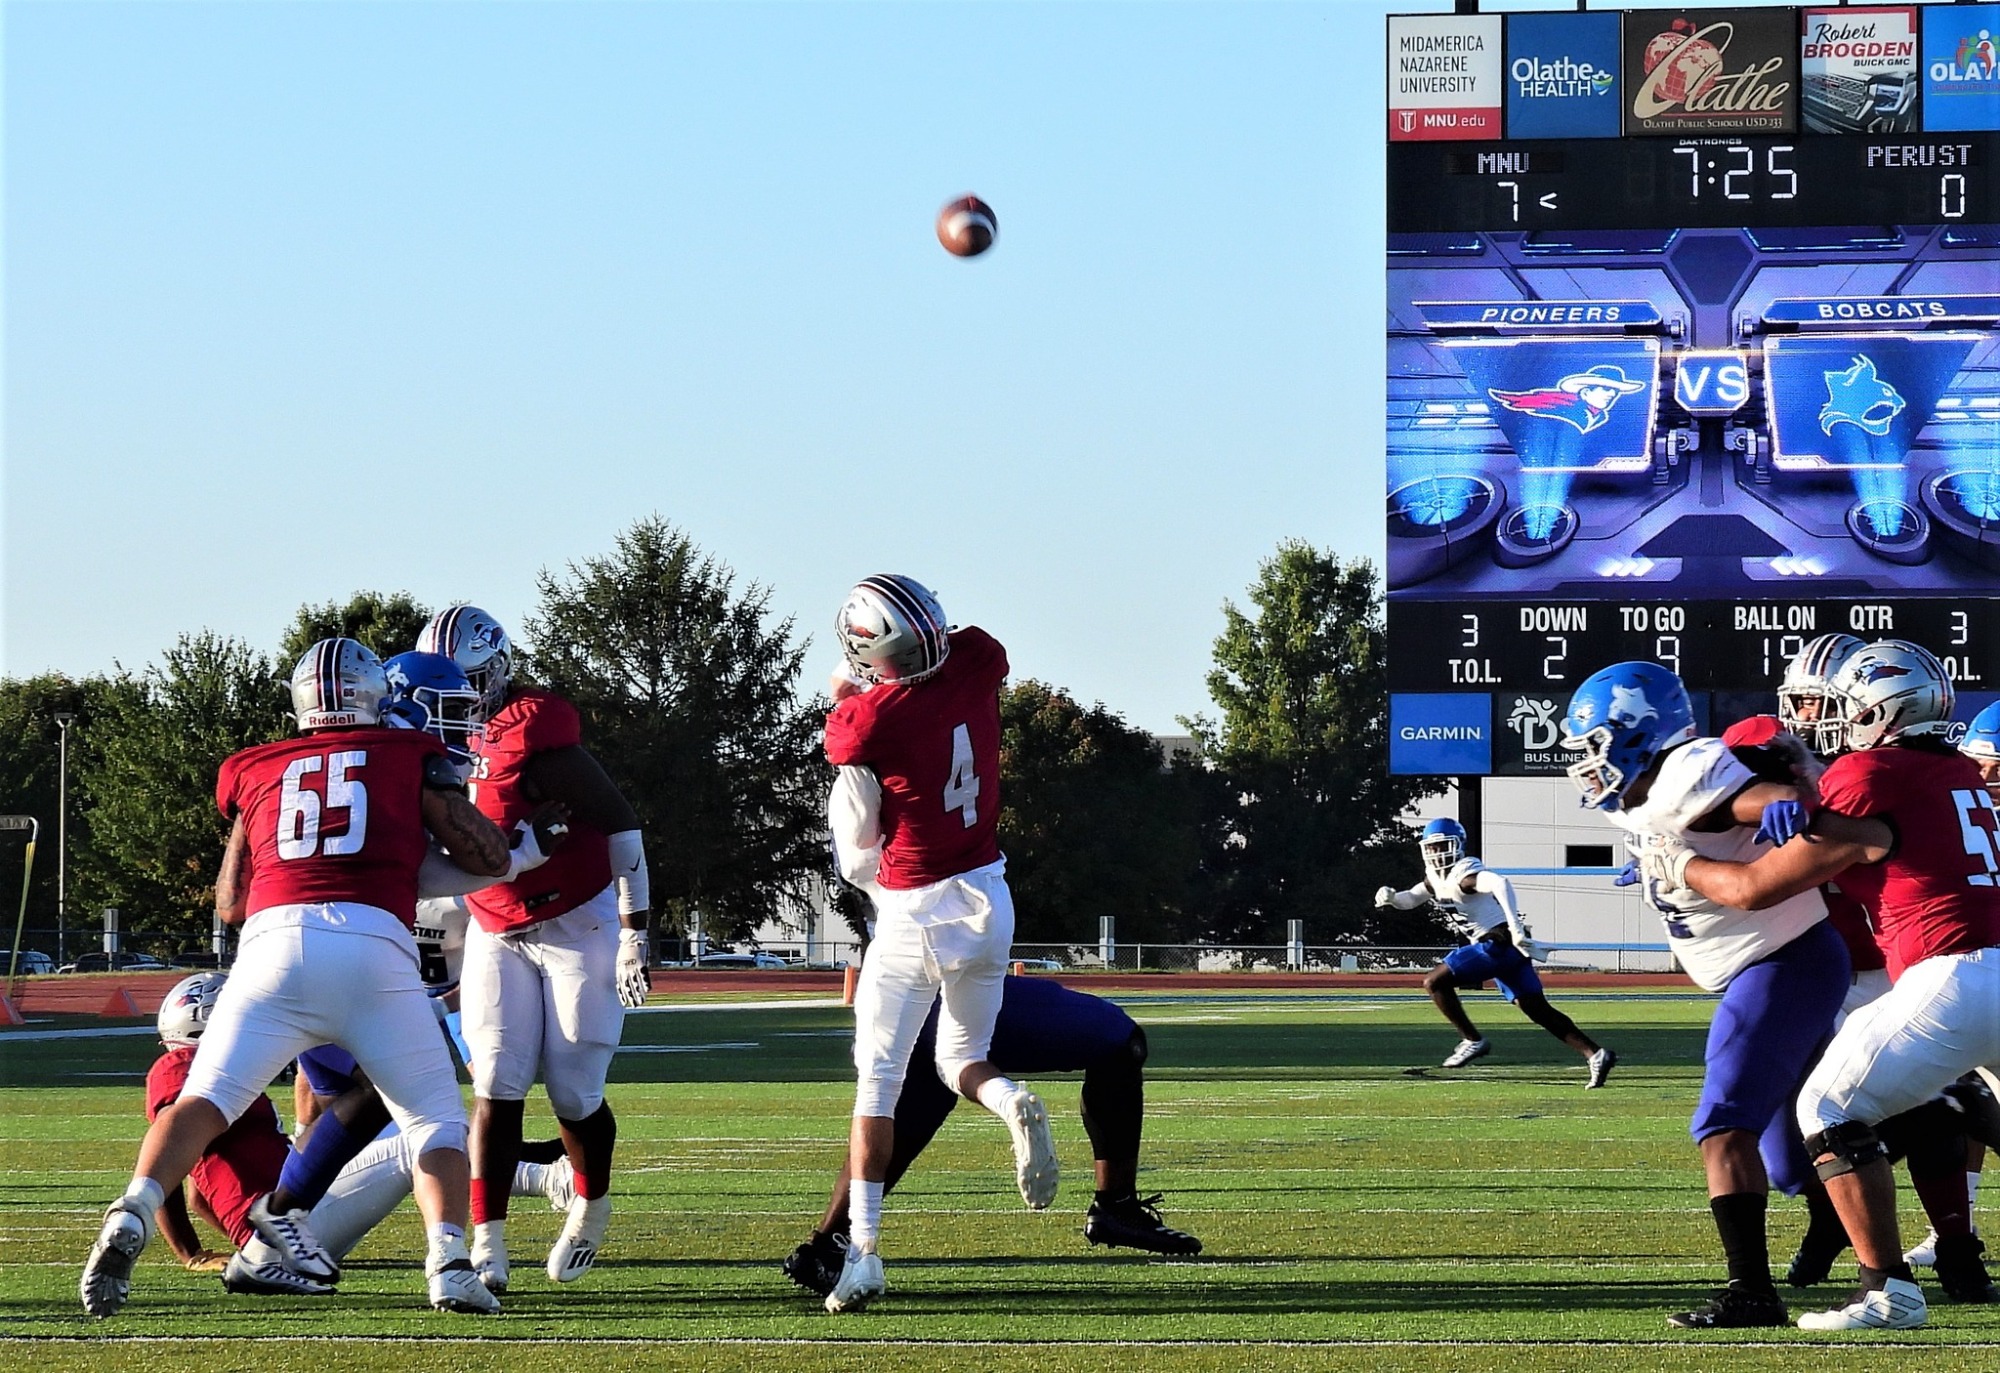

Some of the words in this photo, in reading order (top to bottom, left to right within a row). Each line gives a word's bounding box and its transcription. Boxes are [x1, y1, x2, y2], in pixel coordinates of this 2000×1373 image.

[1400, 35, 1484, 52] MIDAMERICA
[1815, 22, 1876, 44] Robert
[1803, 42, 1914, 59] BROGDEN
[1400, 56, 1468, 72] NAZARENE
[1511, 56, 1594, 82] Olathe
[1633, 21, 1790, 119] Olathe
[1853, 59, 1885, 67] BUICK
[1887, 58, 1911, 66] GMC
[1930, 61, 2000, 82] OLAT
[1400, 77, 1477, 93] UNIVERSITY
[1520, 81, 1592, 98] HEALTH
[1424, 114, 1486, 127] MNU.edu
[1745, 118, 1767, 127] USD
[1769, 118, 1782, 129] 233
[1478, 152, 1530, 174] MNU
[1867, 144, 1972, 167] PERUST
[1672, 146, 1797, 200] 7:25
[1497, 181, 1518, 222] 7
[1941, 173, 1965, 218] 0
[1481, 305, 1621, 323] PIONEERS
[1818, 301, 1947, 320] BOBCATS
[1679, 364, 1746, 403] VS
[1520, 607, 1587, 632] DOWN
[1620, 607, 1649, 632] TO
[1654, 606, 1685, 632] GO
[1734, 606, 1784, 631] BALL
[1788, 605, 1816, 630] ON
[1850, 604, 1893, 632] QTR
[1950, 611, 1968, 645] 3
[1462, 614, 1479, 647] 3
[1543, 636, 1567, 680] 2
[1449, 658, 1502, 683] T.O.L.
[343, 688, 355, 697] 65
[308, 714, 356, 726] Riddell
[1400, 726, 1481, 740] GARMIN
[1524, 753, 1551, 763] BUS
[944, 722, 980, 828] 4
[277, 750, 368, 860] 65
